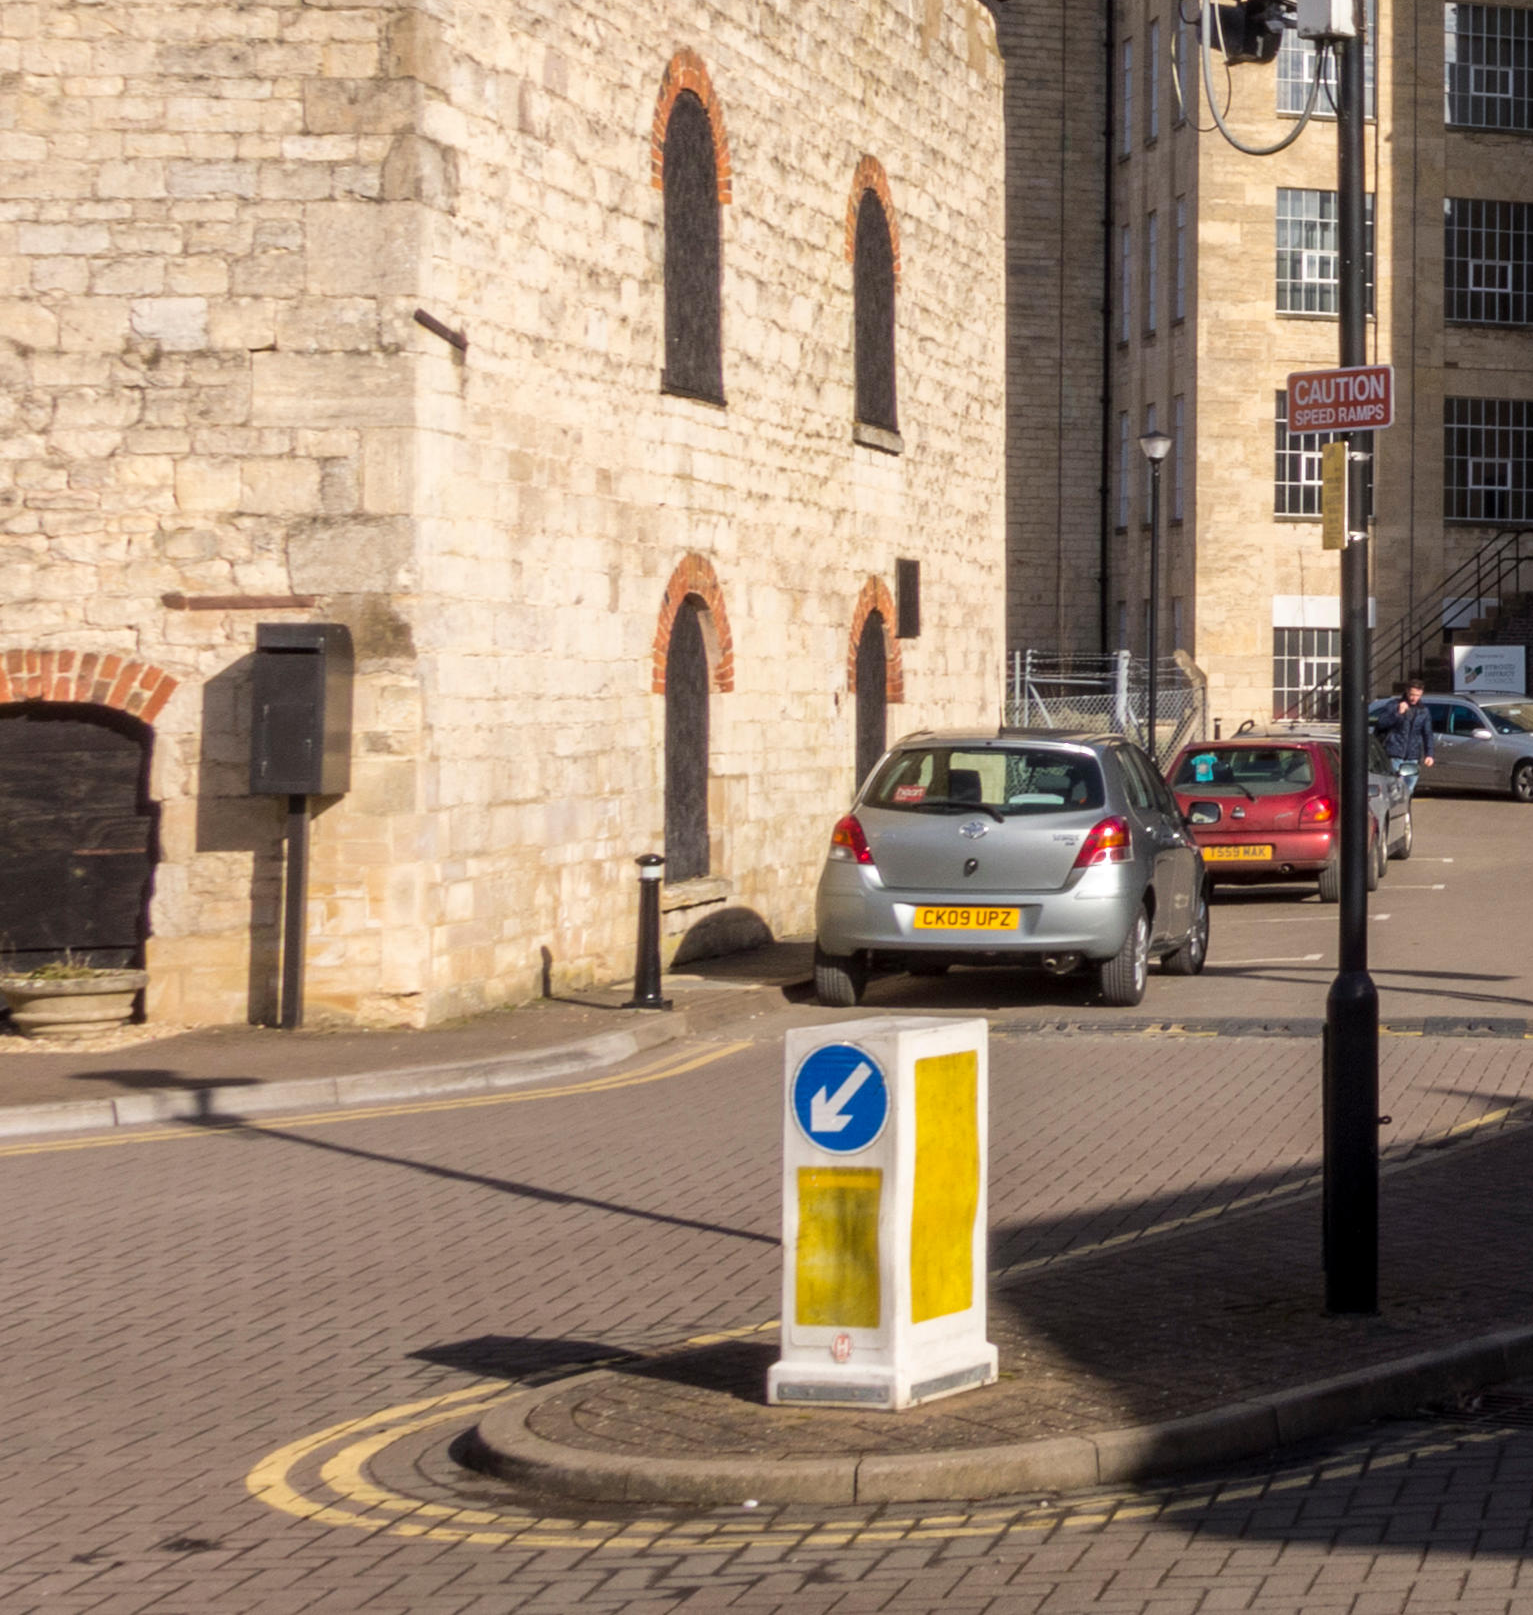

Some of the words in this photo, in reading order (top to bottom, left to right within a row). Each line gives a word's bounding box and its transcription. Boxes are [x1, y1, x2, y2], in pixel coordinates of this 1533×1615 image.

[1294, 373, 1385, 406] CAUTION
[1294, 407, 1336, 426] SPEED
[1338, 404, 1385, 424] RAMPS
[922, 910, 971, 927] CK09
[976, 910, 1012, 927] UPZ
